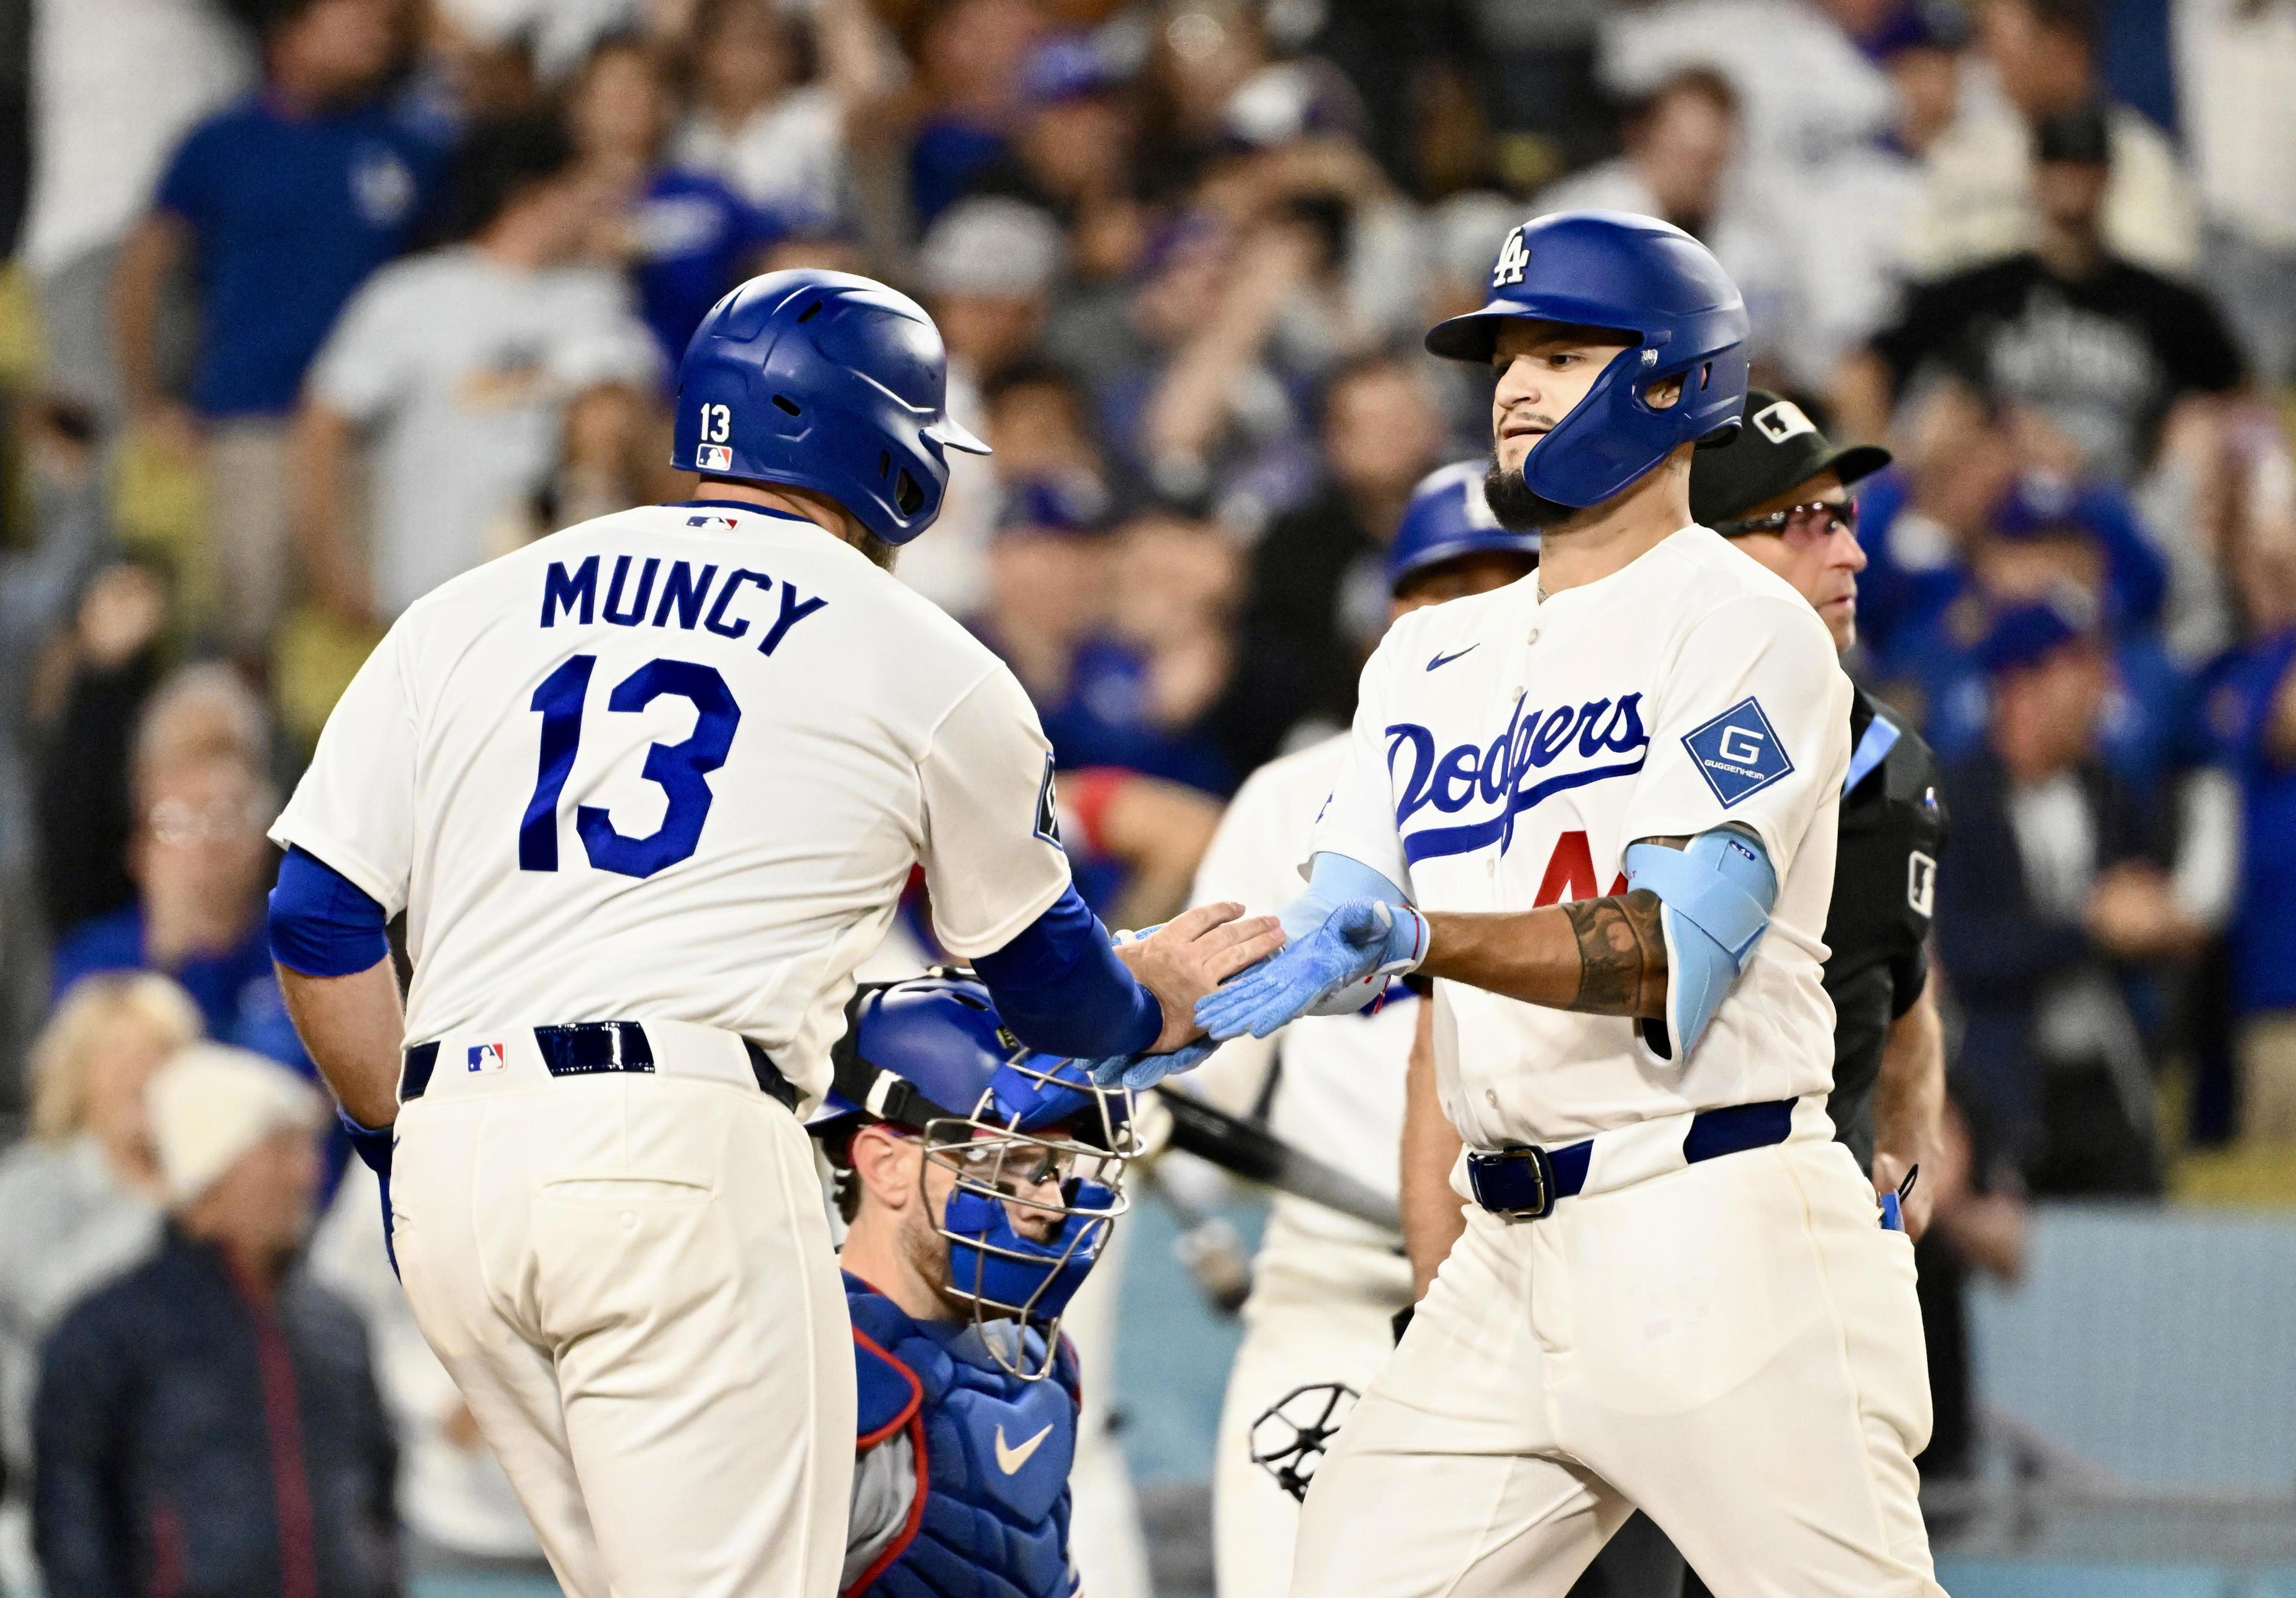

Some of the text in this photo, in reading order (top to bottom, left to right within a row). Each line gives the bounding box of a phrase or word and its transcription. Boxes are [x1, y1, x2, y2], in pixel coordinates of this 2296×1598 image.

[1493, 226, 1530, 287] LA
[700, 403, 731, 442] 13
[540, 555, 829, 657] MUNCY
[519, 654, 742, 880] 13
[1704, 759, 1765, 780] GUGGENHEIM
[1719, 725, 1764, 764] G
[1385, 689, 1651, 862] Dodgers
